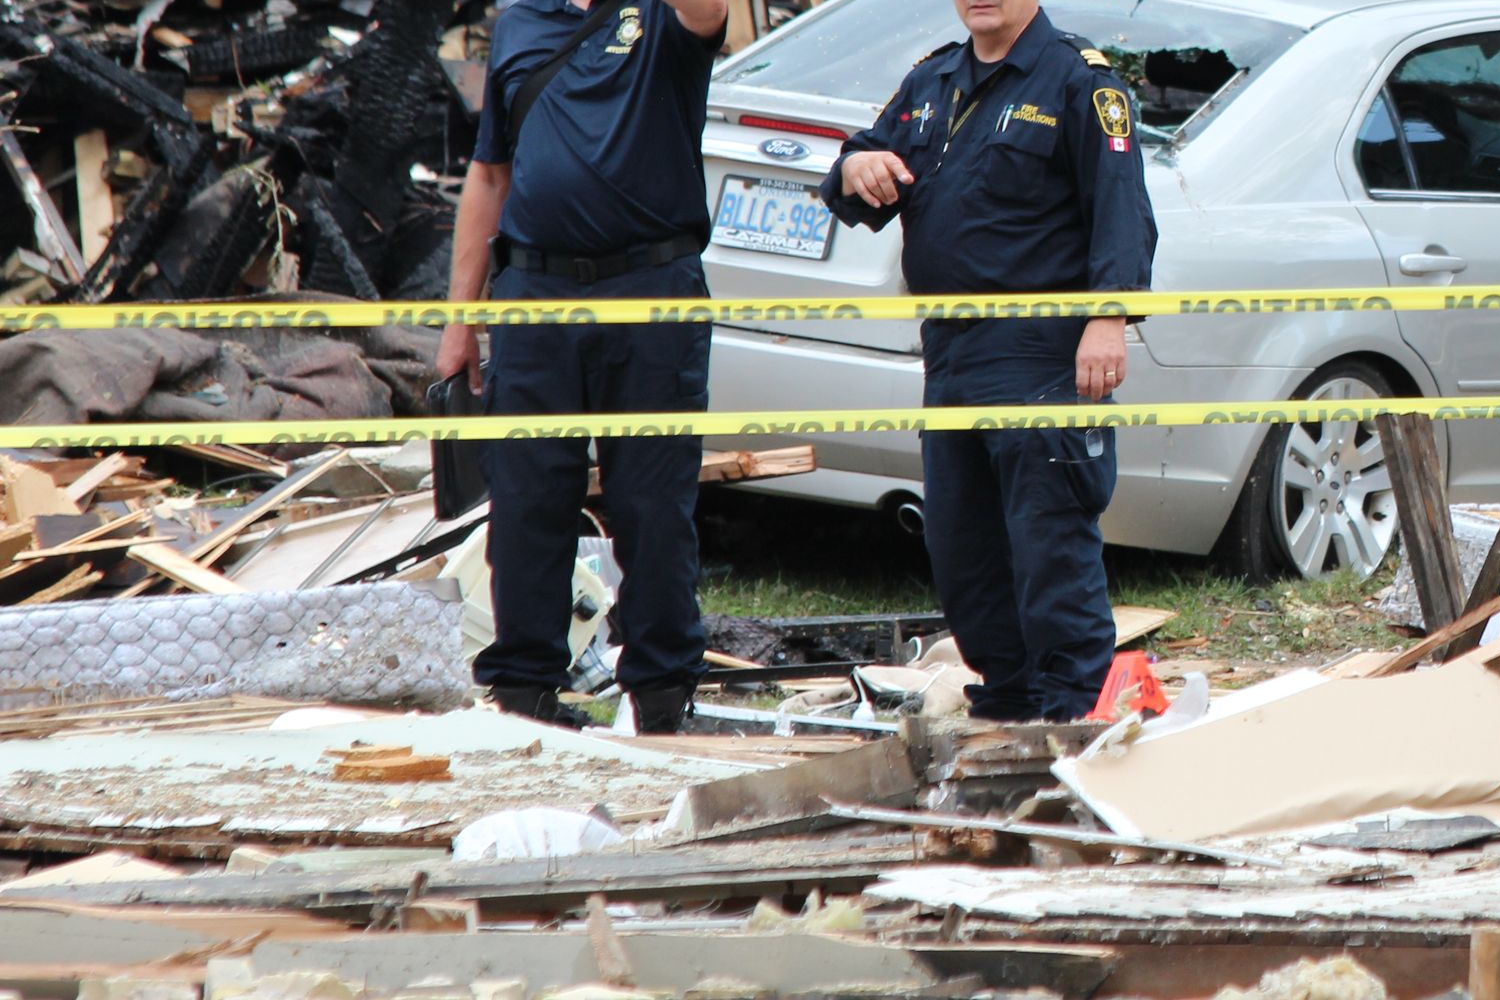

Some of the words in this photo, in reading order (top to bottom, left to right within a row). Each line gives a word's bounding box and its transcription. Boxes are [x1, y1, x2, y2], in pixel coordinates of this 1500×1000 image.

[1021, 103, 1039, 114] FIRE
[766, 140, 798, 156] Ford
[718, 193, 777, 233] BLLC
[786, 203, 831, 241] 992
